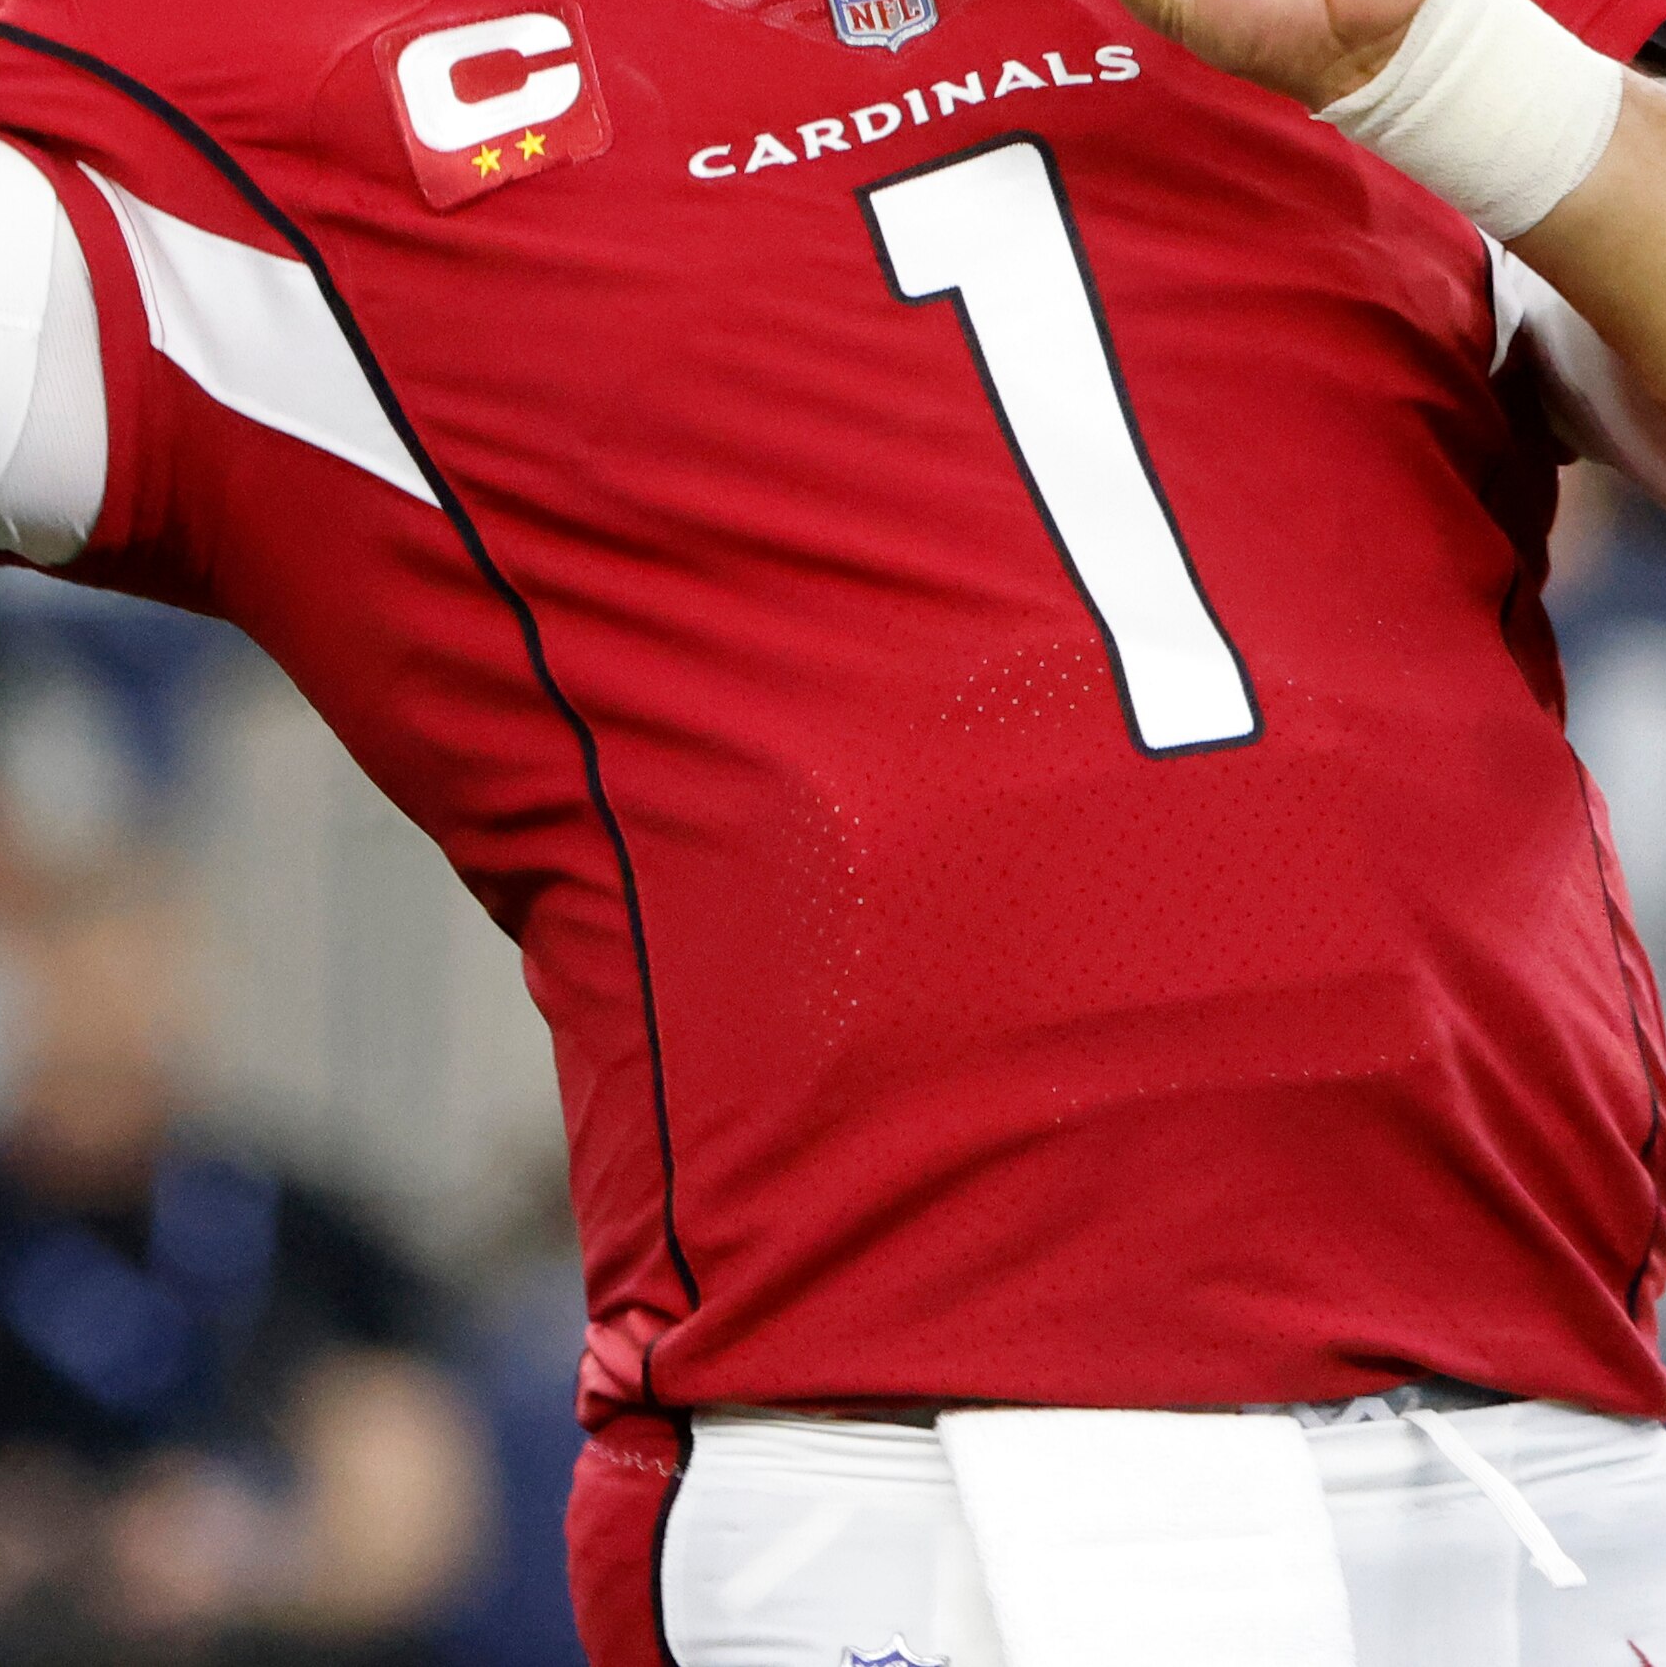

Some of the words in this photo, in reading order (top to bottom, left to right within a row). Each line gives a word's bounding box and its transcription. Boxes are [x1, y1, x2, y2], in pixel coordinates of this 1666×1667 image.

[396, 12, 582, 153] C
[687, 44, 1141, 179] CARDINALS
[854, 130, 1264, 759] 1
